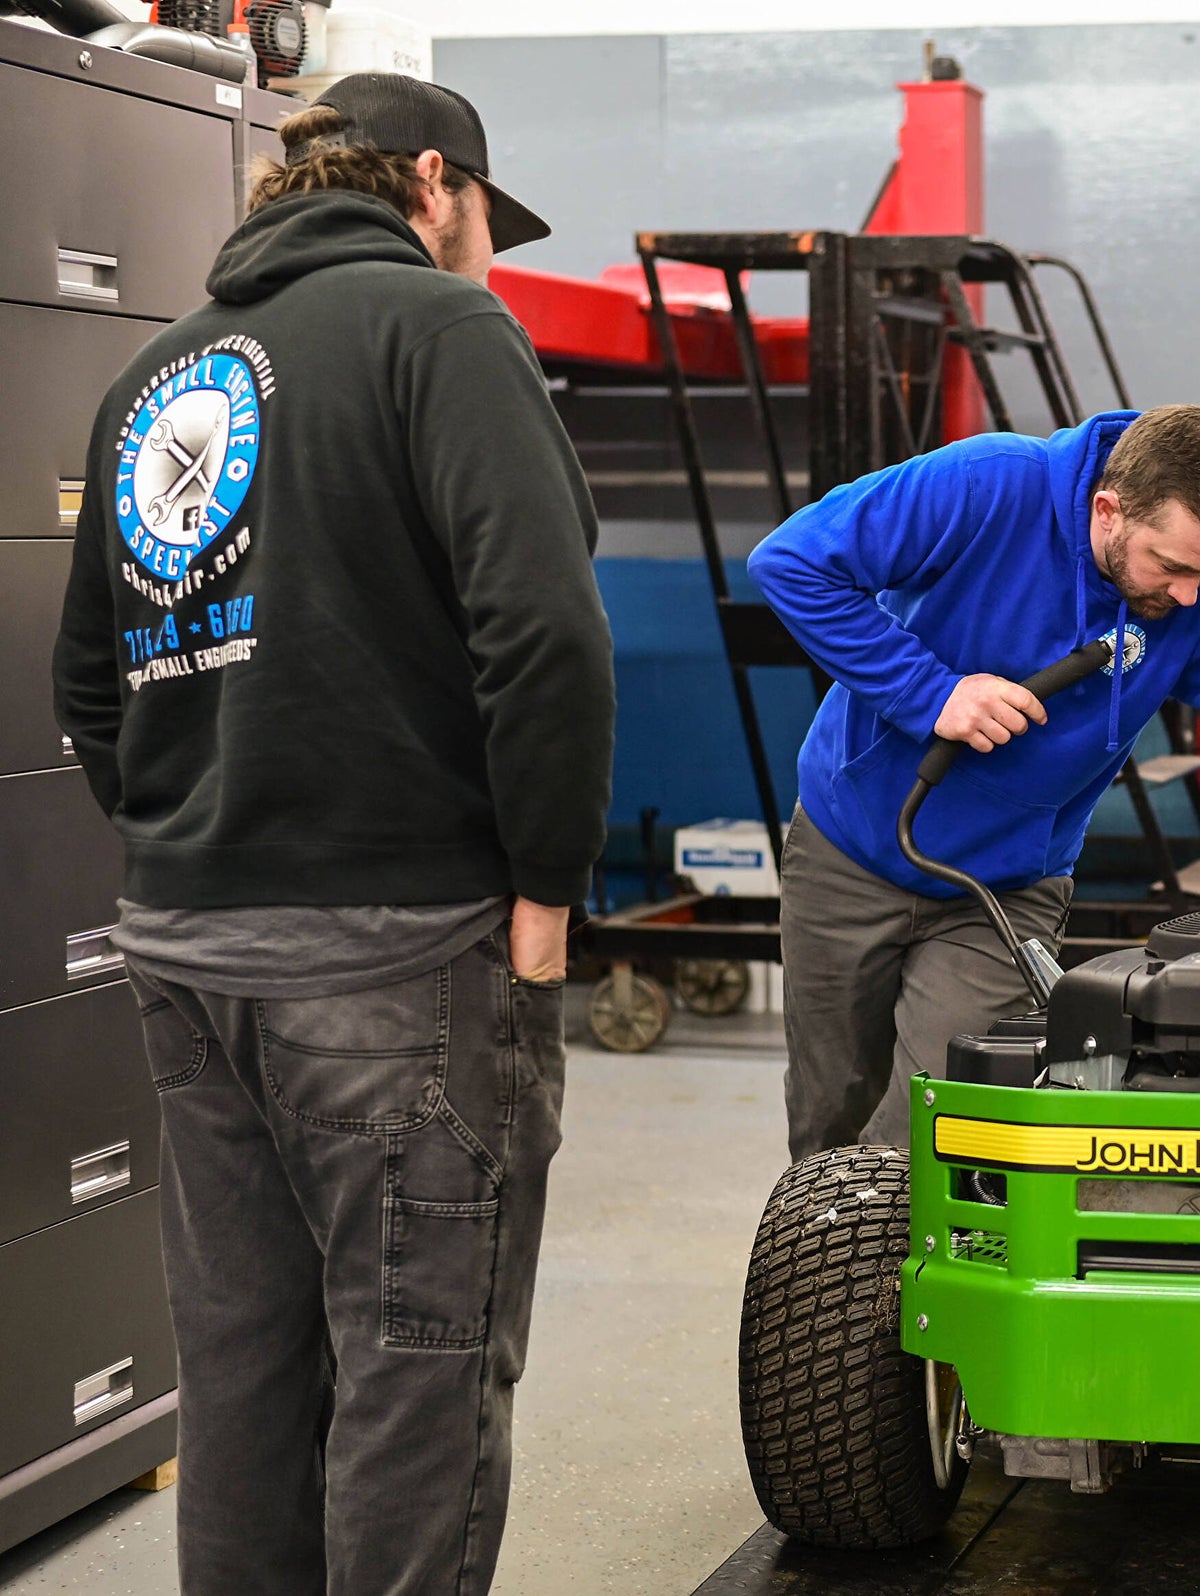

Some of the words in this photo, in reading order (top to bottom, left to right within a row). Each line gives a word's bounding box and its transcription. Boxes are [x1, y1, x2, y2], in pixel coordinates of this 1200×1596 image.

[118, 429, 145, 484] THE
[146, 359, 215, 419] SMALL
[223, 362, 257, 448] ENGINE
[1077, 1136, 1183, 1168] JOHN
